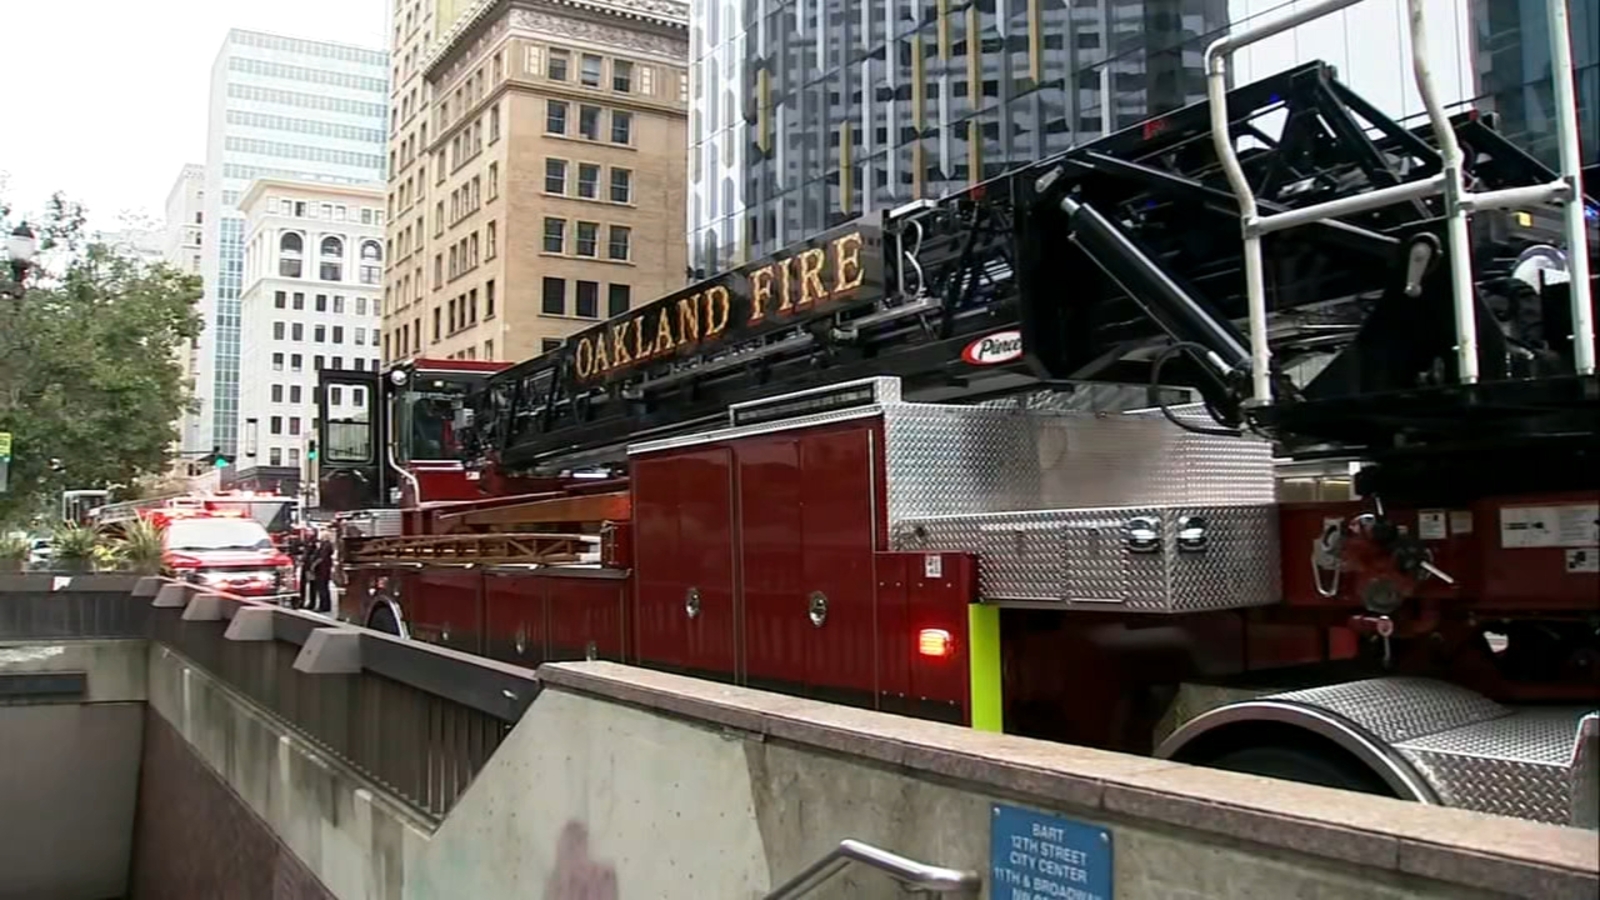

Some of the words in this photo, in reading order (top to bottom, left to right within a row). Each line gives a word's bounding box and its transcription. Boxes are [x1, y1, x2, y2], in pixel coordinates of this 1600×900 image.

[575, 285, 730, 379] OAKLAND
[748, 232, 865, 321] FIRE
[1032, 823, 1064, 842] BART
[1011, 835, 1038, 853] 12TH
[1040, 842, 1087, 866] STREET
[994, 866, 1021, 885] 11TH
[1010, 851, 1037, 870] CITY
[1038, 859, 1088, 884] CENTER
